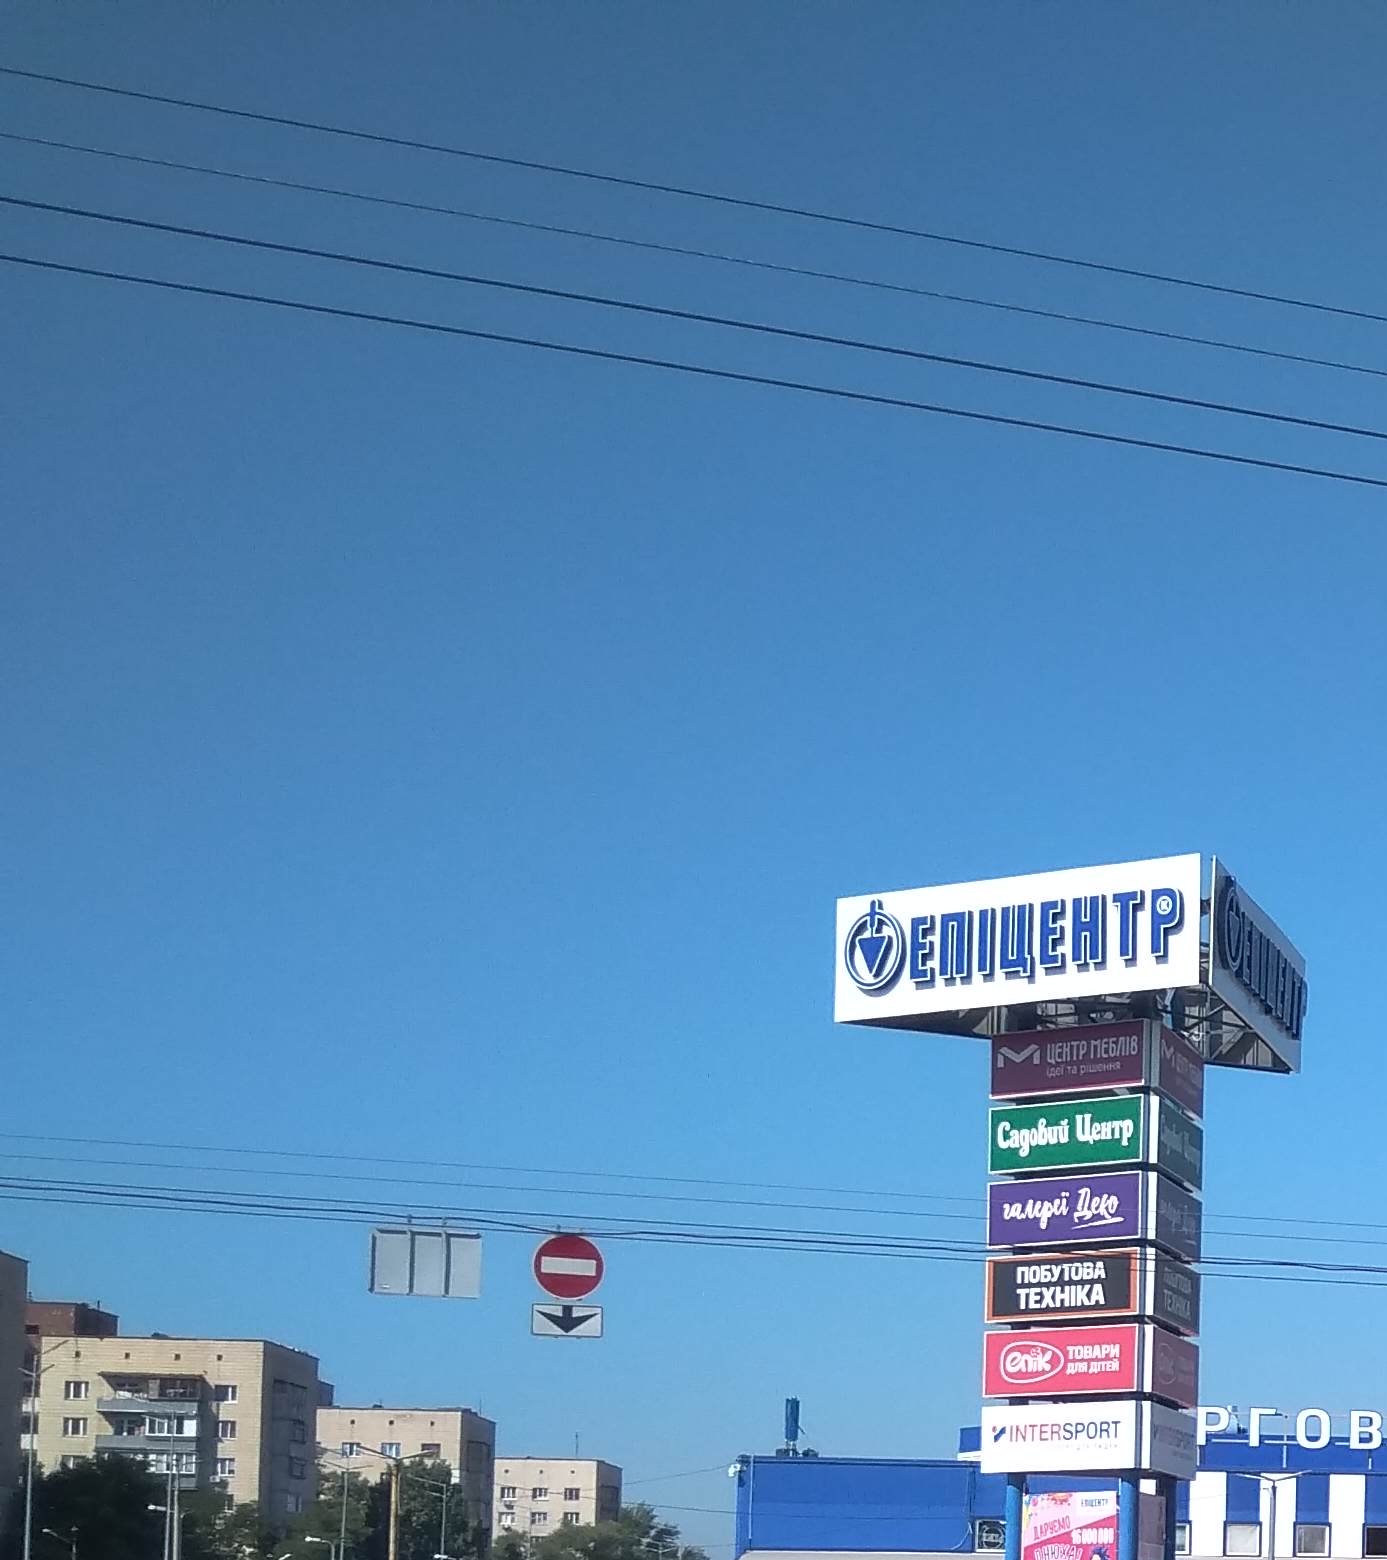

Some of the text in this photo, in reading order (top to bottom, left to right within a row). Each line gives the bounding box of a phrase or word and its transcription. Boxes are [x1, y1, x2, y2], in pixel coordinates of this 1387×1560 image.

[908, 888, 1183, 983] ЕПІЦЕНТР
[1046, 1035, 1139, 1065] ЦЕНТР МЕБЛІВ
[1067, 1065, 1078, 1075] та
[997, 1117, 1070, 1158] Садовий
[1075, 1113, 1134, 1147] Центр
[1002, 1191, 1069, 1230] галереї
[1073, 1187, 1120, 1223] Деко
[1016, 1261, 1106, 1285] ПОБУТОВА
[1016, 1285, 1106, 1311] ТЕХНІКА
[1066, 1343, 1120, 1361] ТОВАРИ
[1065, 1358, 1120, 1376] ДЛЯ ДІТЕЙ
[1009, 1420, 1121, 1443] INTERSPORT
